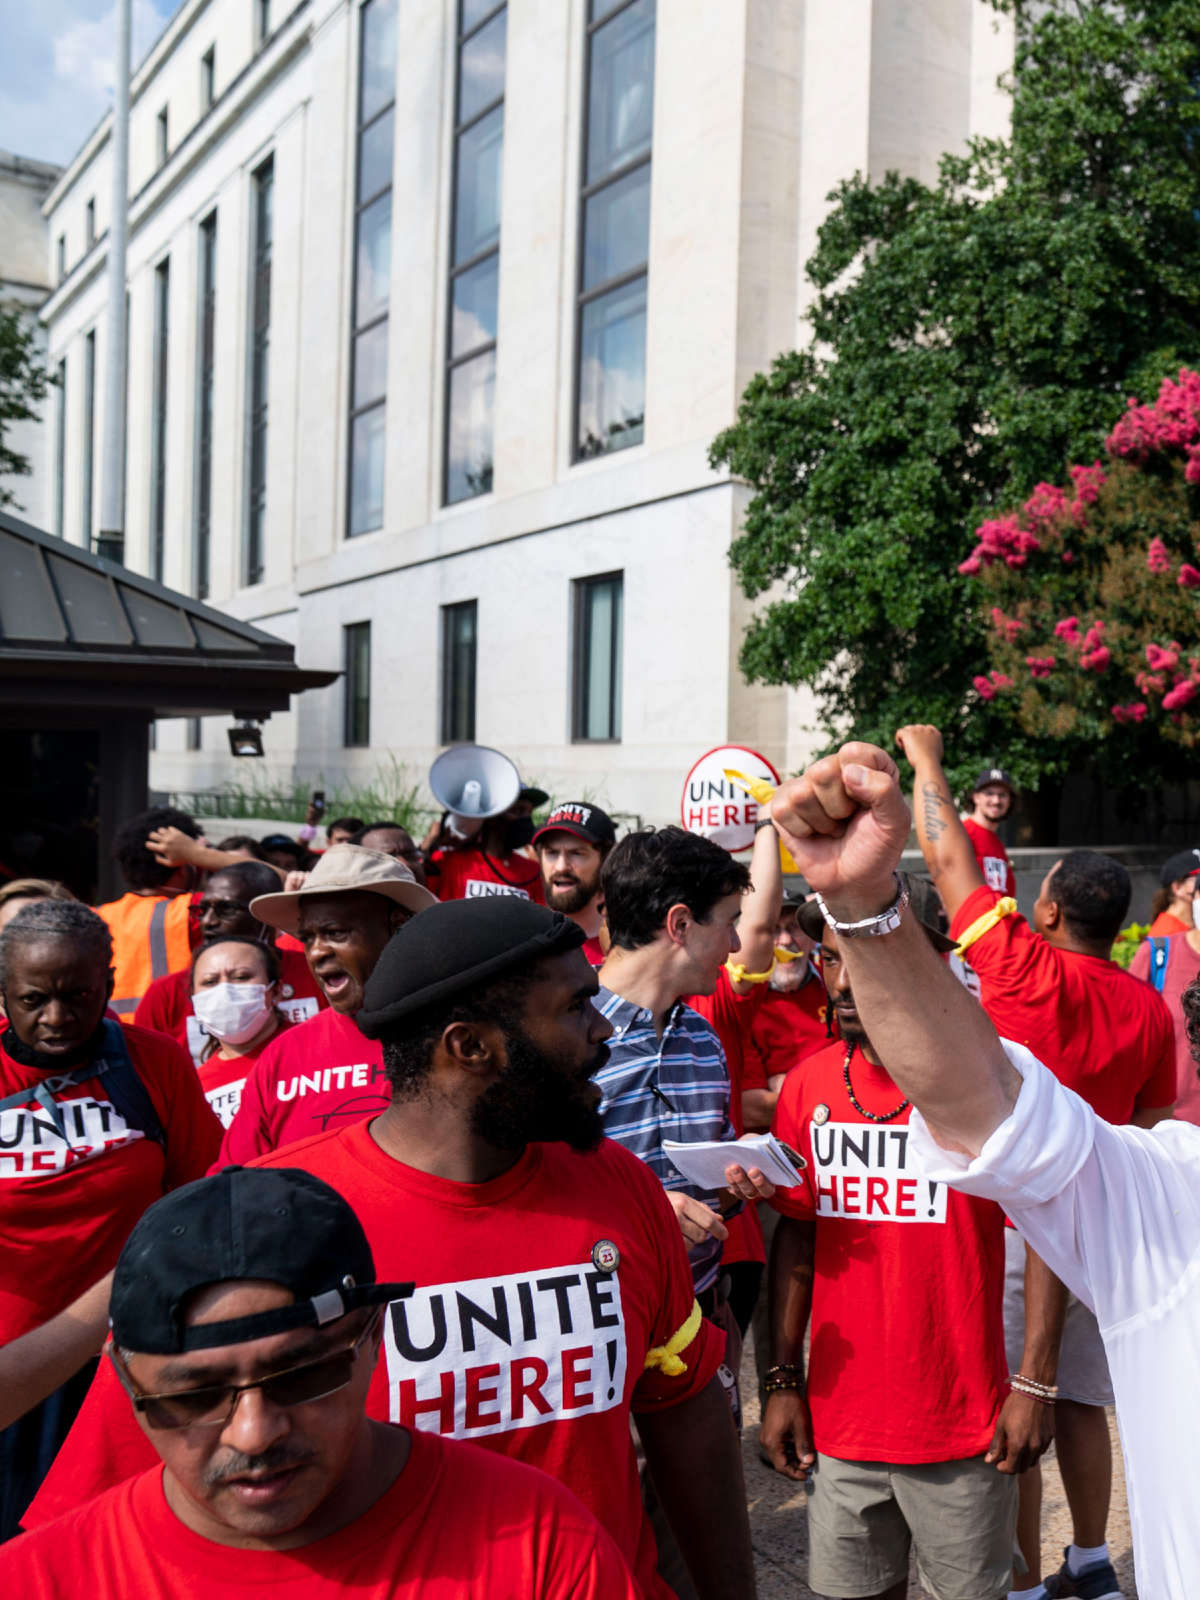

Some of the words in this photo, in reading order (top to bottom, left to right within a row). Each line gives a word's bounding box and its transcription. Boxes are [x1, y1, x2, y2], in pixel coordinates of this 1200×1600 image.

[813, 1128, 909, 1170] UNIT
[816, 1174, 938, 1218] HERE!
[390, 1272, 620, 1363] UNITE
[399, 1339, 618, 1435] HERE!
